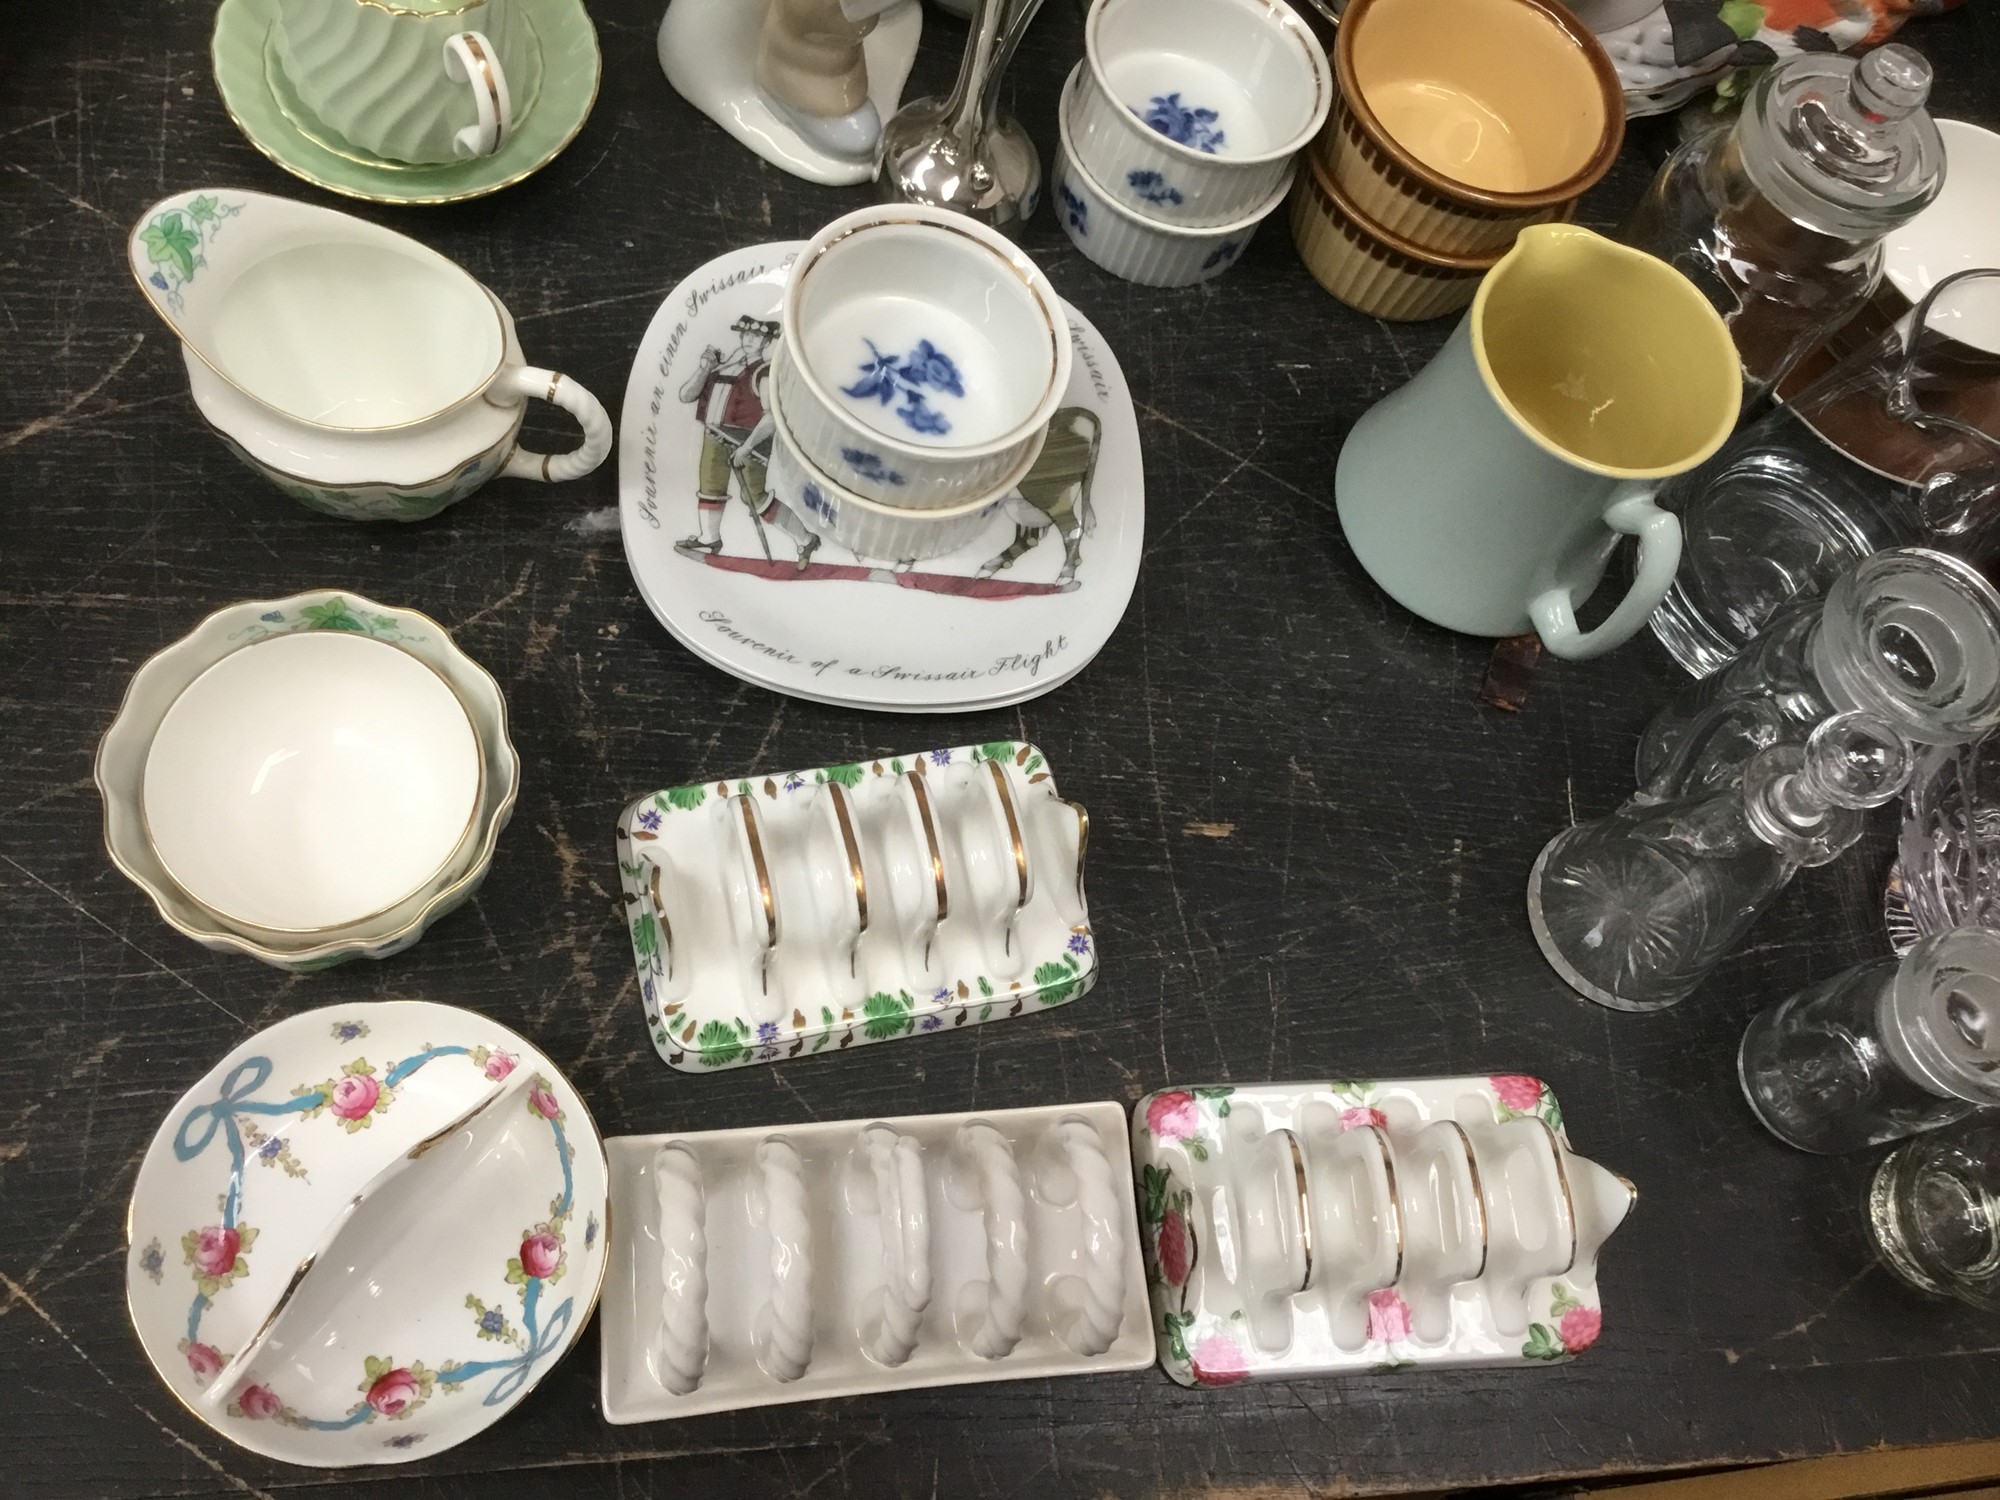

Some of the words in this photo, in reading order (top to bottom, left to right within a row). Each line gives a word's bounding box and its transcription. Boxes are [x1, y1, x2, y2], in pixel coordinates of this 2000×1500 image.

[637, 422, 661, 529] Souvenir
[649, 379, 665, 415] an
[658, 320, 688, 377] einen
[685, 261, 767, 317] Swissair
[699, 610, 801, 664] Souvenir
[810, 659, 839, 677] of
[847, 667, 868, 676] a
[871, 665, 985, 681] Swissair
[988, 634, 1068, 677] Flight
